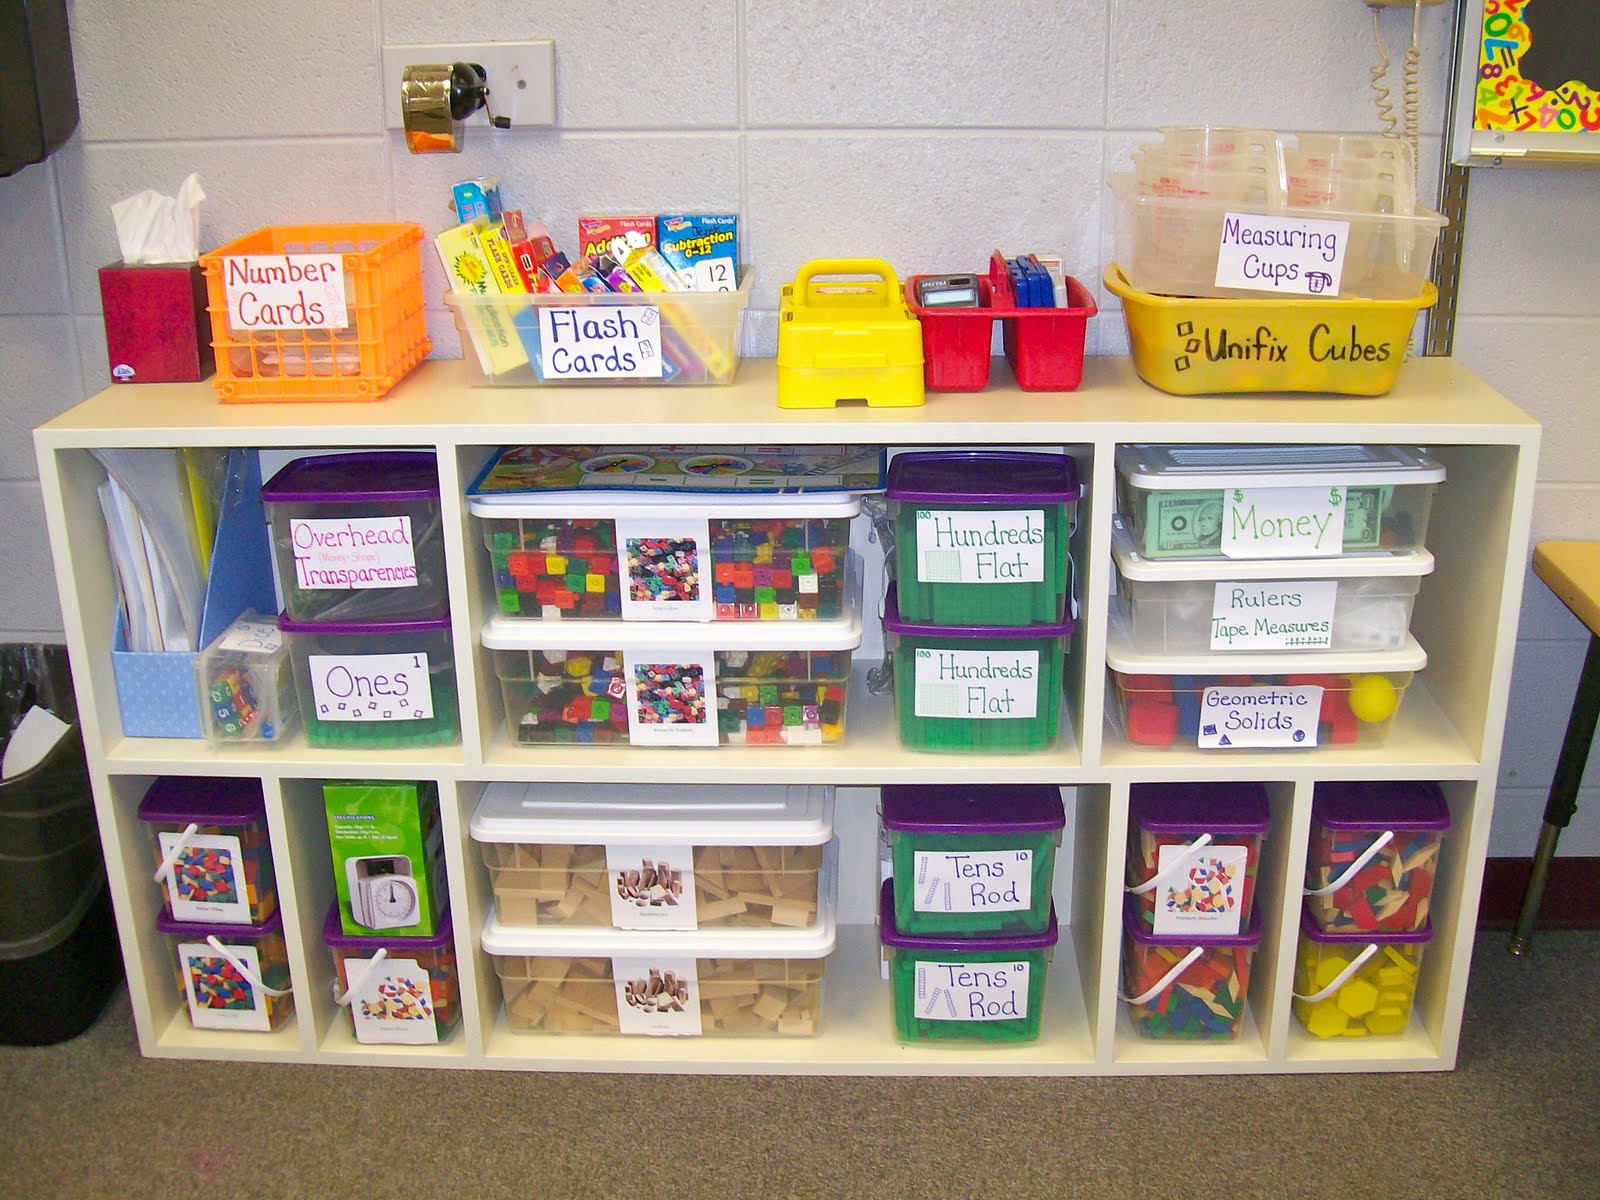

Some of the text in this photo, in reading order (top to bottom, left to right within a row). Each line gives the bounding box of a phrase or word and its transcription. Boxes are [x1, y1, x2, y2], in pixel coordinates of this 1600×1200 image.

[662, 231, 734, 255] Subtraction
[1222, 217, 1337, 263] Measuring
[229, 256, 336, 287] Number
[709, 264, 728, 283] 12
[1243, 253, 1300, 287] Cups
[239, 289, 325, 326] Cards
[549, 309, 640, 343] Flash
[1204, 322, 1391, 363] Unifix Cubes
[552, 345, 637, 374] Cards
[294, 518, 410, 549] Overhead
[917, 511, 1044, 548] 100 Hundreds
[1231, 503, 1334, 549] Money
[294, 555, 418, 591] Transparencies
[976, 551, 1029, 580] Flat
[1231, 587, 1303, 609] Rulers
[1211, 616, 1330, 645] Tape Measures
[413, 655, 421, 668] 1
[916, 650, 1033, 681] 100 Hundreds
[326, 665, 410, 698] Ones
[967, 686, 1016, 714] Flat
[1206, 689, 1309, 708] Geometric
[1225, 709, 1293, 731] Solids
[945, 852, 1029, 879] Tens 10
[970, 881, 1021, 907] Rod
[937, 963, 1025, 988] Tens 10
[968, 990, 1019, 1018] Rod
